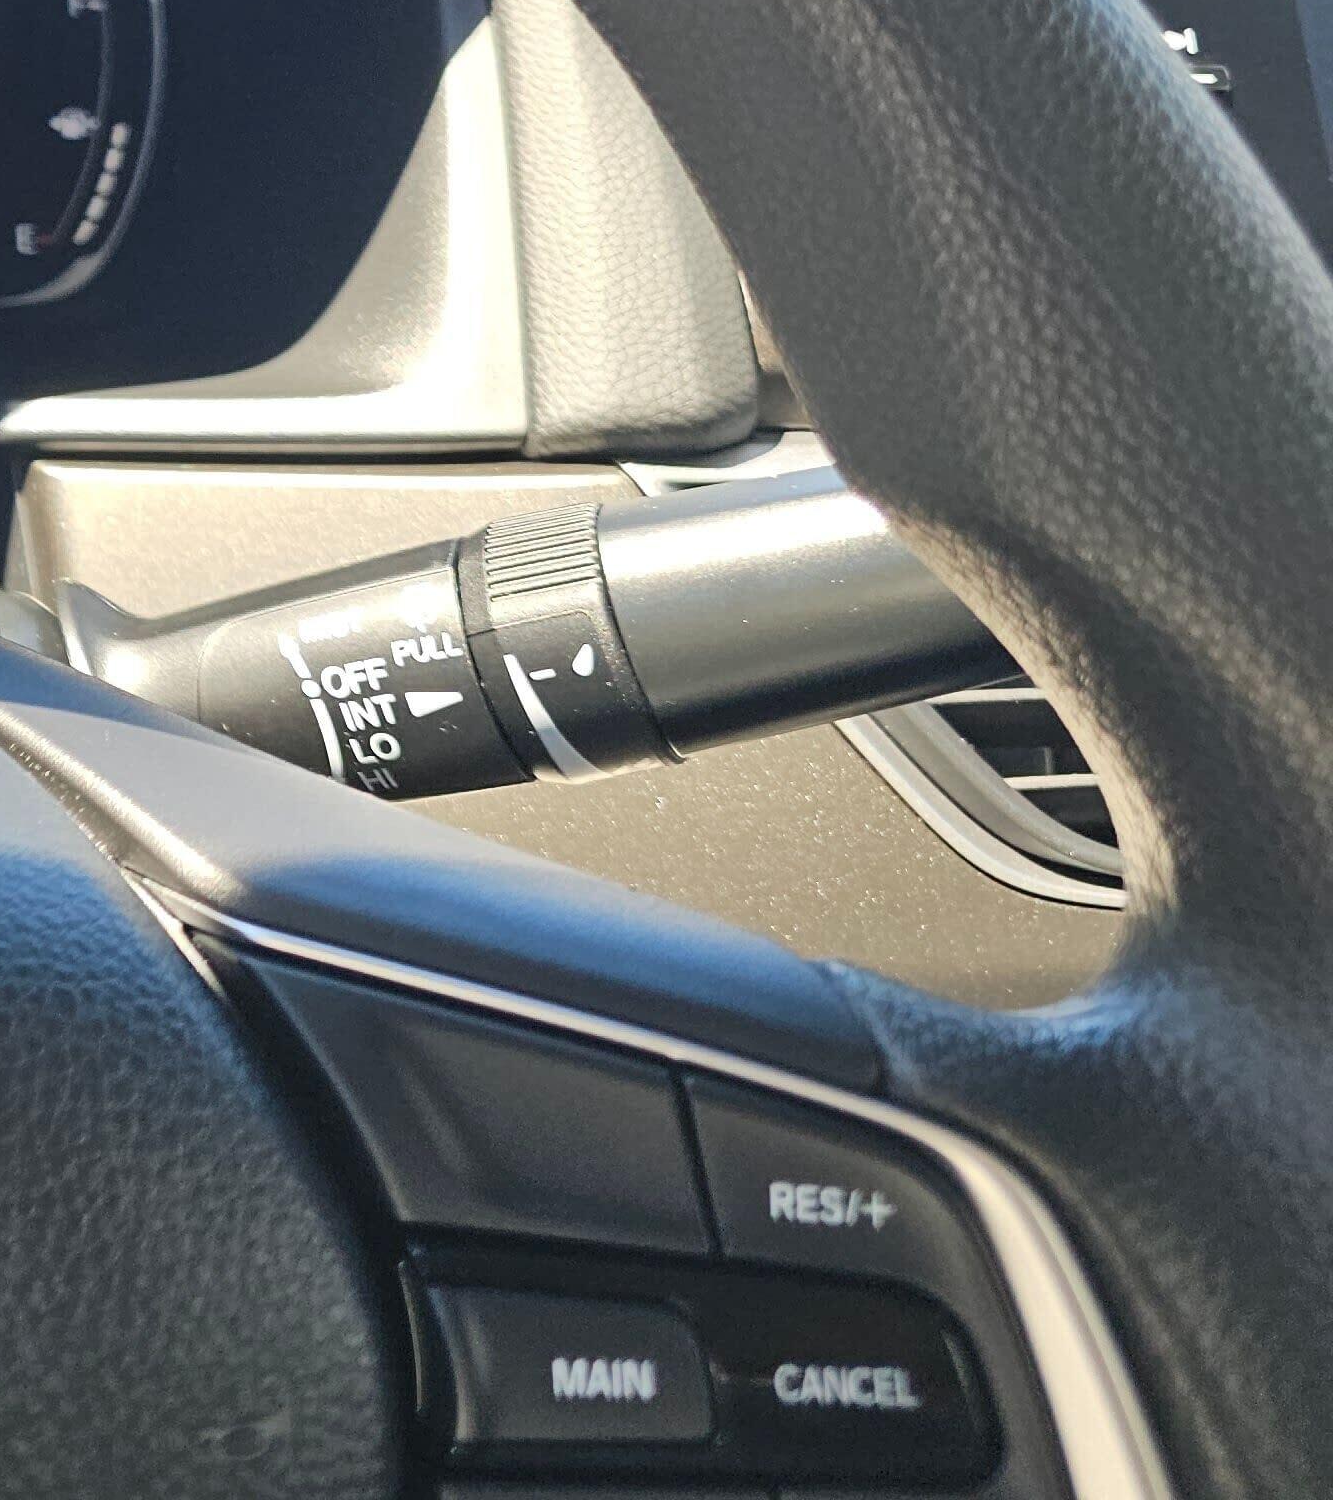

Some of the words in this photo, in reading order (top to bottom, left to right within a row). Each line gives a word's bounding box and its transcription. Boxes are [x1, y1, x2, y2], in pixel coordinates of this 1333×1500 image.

[390, 632, 464, 667] PULL
[320, 657, 390, 699] OFF
[339, 693, 396, 733] INT
[349, 732, 401, 765] LO
[552, 1358, 656, 1401] MAIN
[774, 1364, 919, 1409] CANCEL
